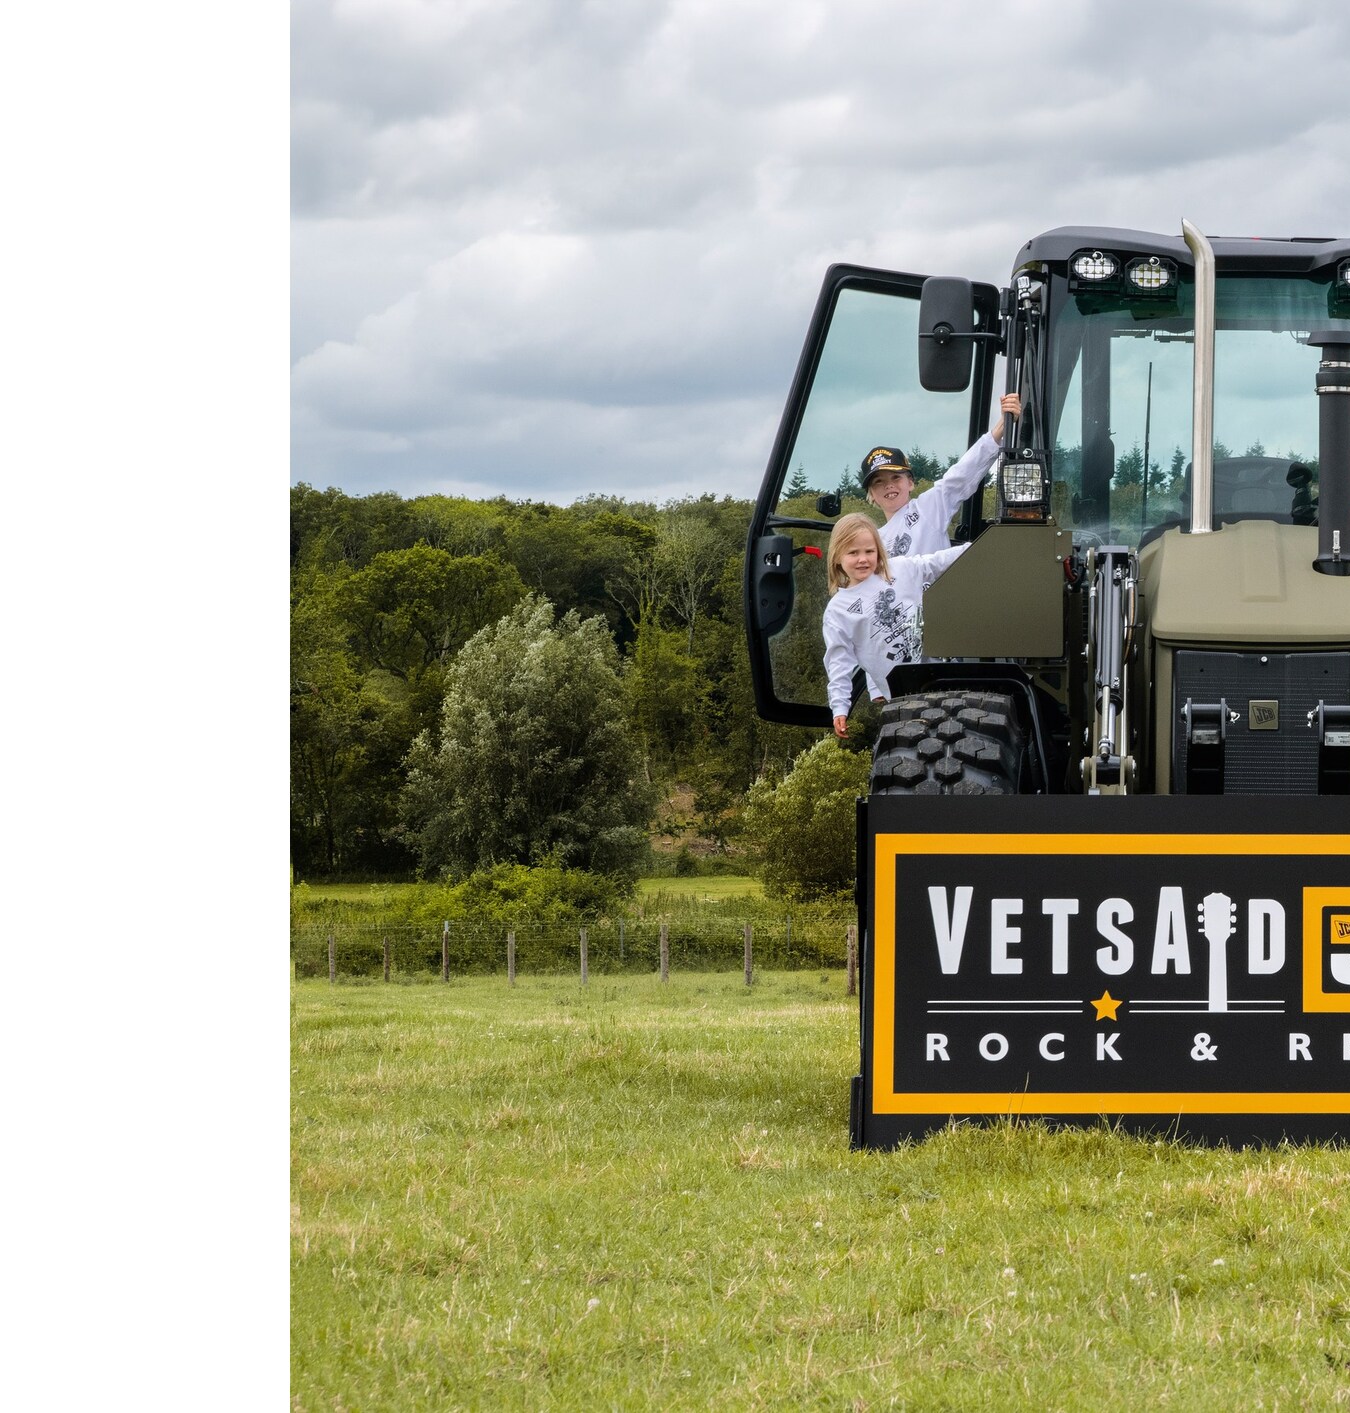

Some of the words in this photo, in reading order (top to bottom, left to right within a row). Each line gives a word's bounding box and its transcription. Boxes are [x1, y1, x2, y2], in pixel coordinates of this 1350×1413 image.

[1256, 707, 1275, 722] JCB
[926, 1032, 1123, 1062] ROCK
[1191, 1032, 1219, 1062] &
